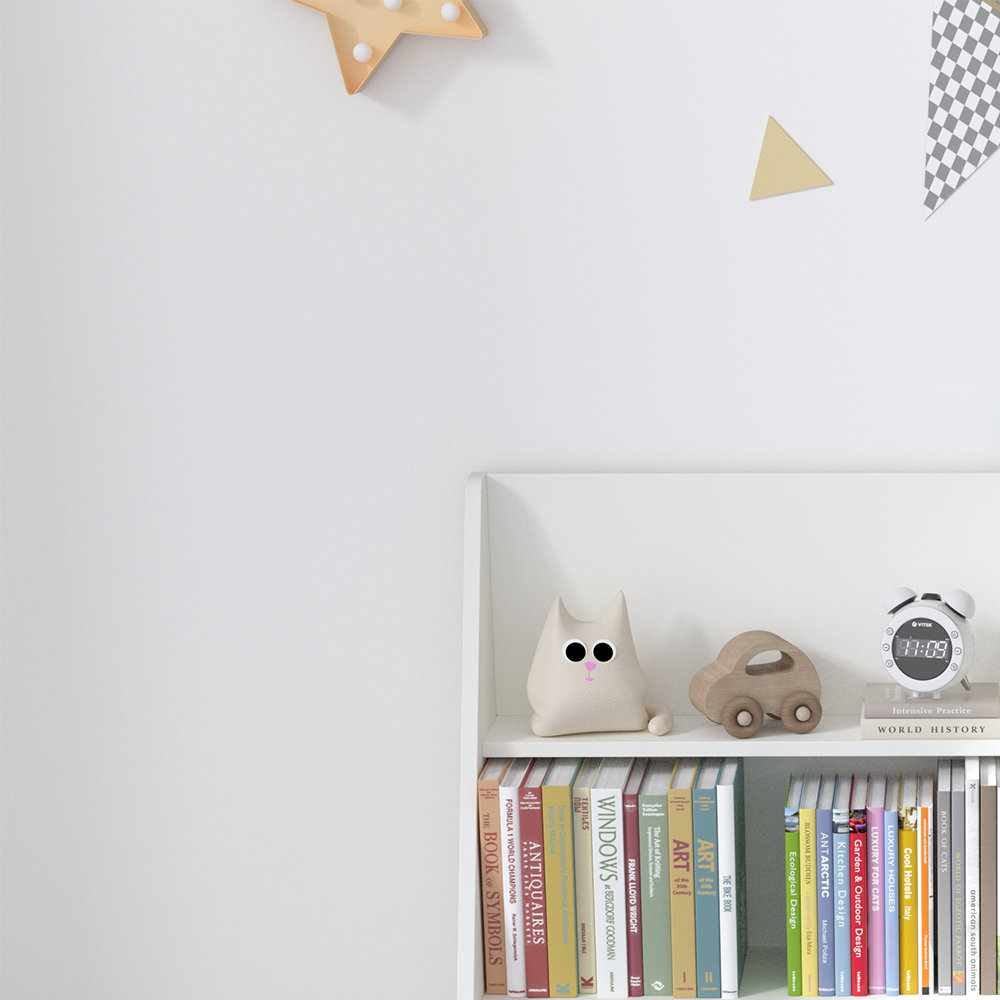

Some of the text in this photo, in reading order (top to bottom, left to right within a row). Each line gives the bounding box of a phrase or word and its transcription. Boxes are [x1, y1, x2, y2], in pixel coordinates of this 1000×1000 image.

[904, 640, 948, 659] 11:09
[892, 707, 972, 715] Intensive Practice
[877, 726, 987, 734] WORLD HISTORY
[482, 813, 490, 829] THE
[505, 798, 514, 832] FORMULA
[581, 797, 590, 830] TEXTILES
[940, 810, 948, 834] BOOK
[483, 832, 499, 875] BOOK
[507, 838, 515, 863] WORLD
[597, 795, 619, 881] WINDOWS
[887, 825, 896, 867] LUXURY
[940, 837, 948, 849] OF
[672, 839, 690, 873] ART
[697, 839, 715, 873] ART
[820, 832, 830, 899] ANTARCTIC
[853, 839, 863, 873] Garden
[871, 826, 879, 912] LUXURY FOR CATS
[954, 852, 962, 881] WORLD
[508, 863, 517, 904] CHAMPIONS
[529, 841, 545, 945] ANTIQUAIRES
[628, 858, 638, 934] FRANK LLOYD WRIGHT
[722, 875, 733, 913] THE BIKE BOOK
[788, 851, 798, 930] Ecological Design
[836, 841, 847, 928] Kitchen Design
[888, 869, 896, 913] HOUSES
[903, 847, 913, 921] Cool Hotels Italy
[854, 885, 863, 925] Outdoor
[486, 891, 503, 966] SYMBOLS
[853, 928, 864, 959] Design
[970, 932, 978, 955] south
[970, 957, 978, 992] animals
